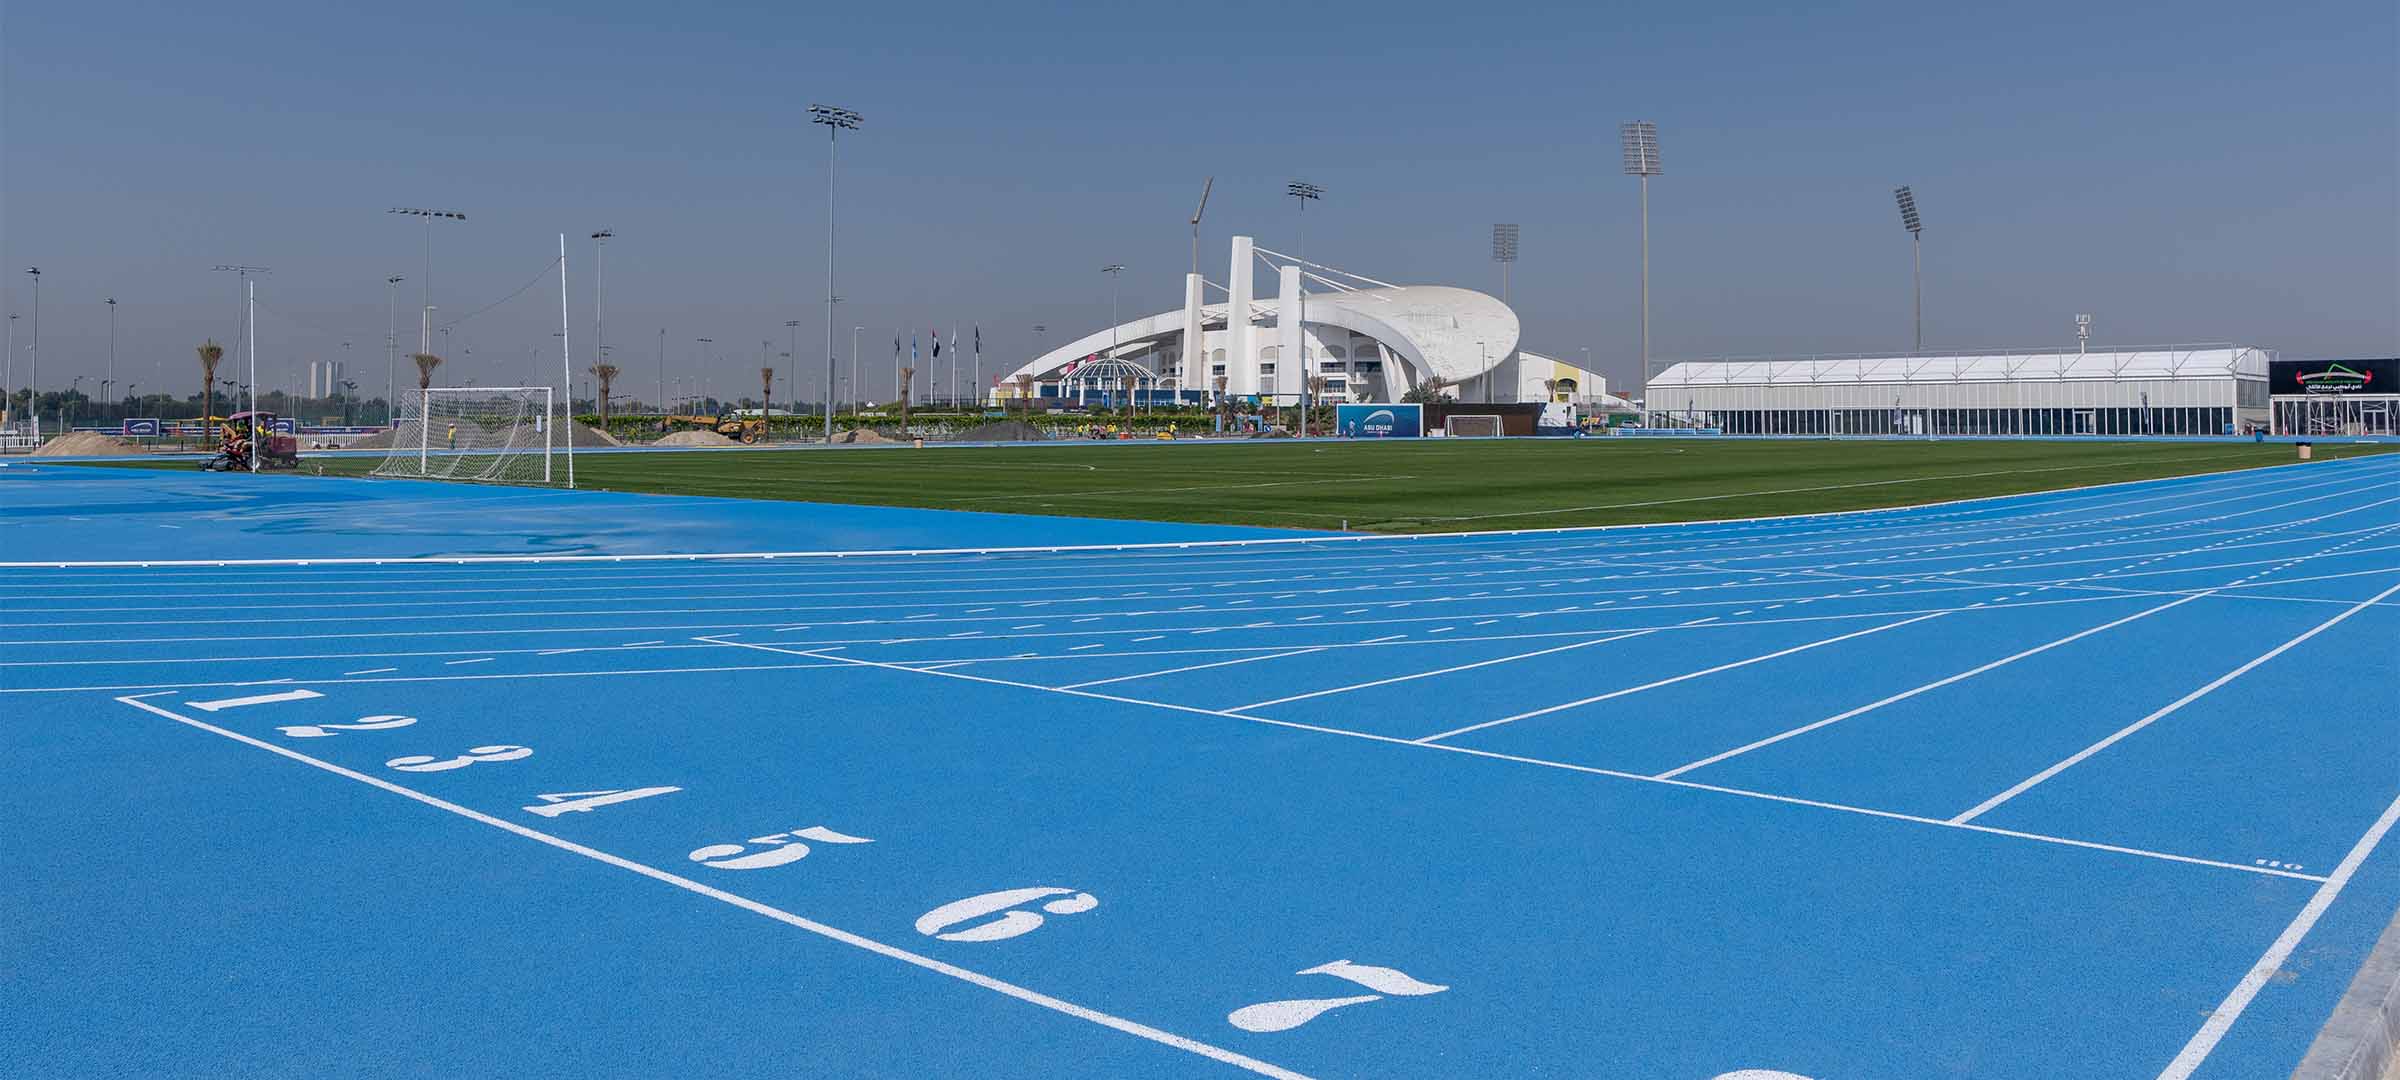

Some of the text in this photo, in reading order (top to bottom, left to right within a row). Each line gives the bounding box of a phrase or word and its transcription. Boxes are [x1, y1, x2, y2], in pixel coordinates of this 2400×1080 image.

[185, 689, 325, 711] 1
[276, 714, 417, 737] 2
[386, 745, 533, 772] 3
[523, 786, 682, 817] 4
[689, 826, 875, 869] 5
[915, 886, 1098, 942] 6
[1228, 959, 1449, 1033] 7
